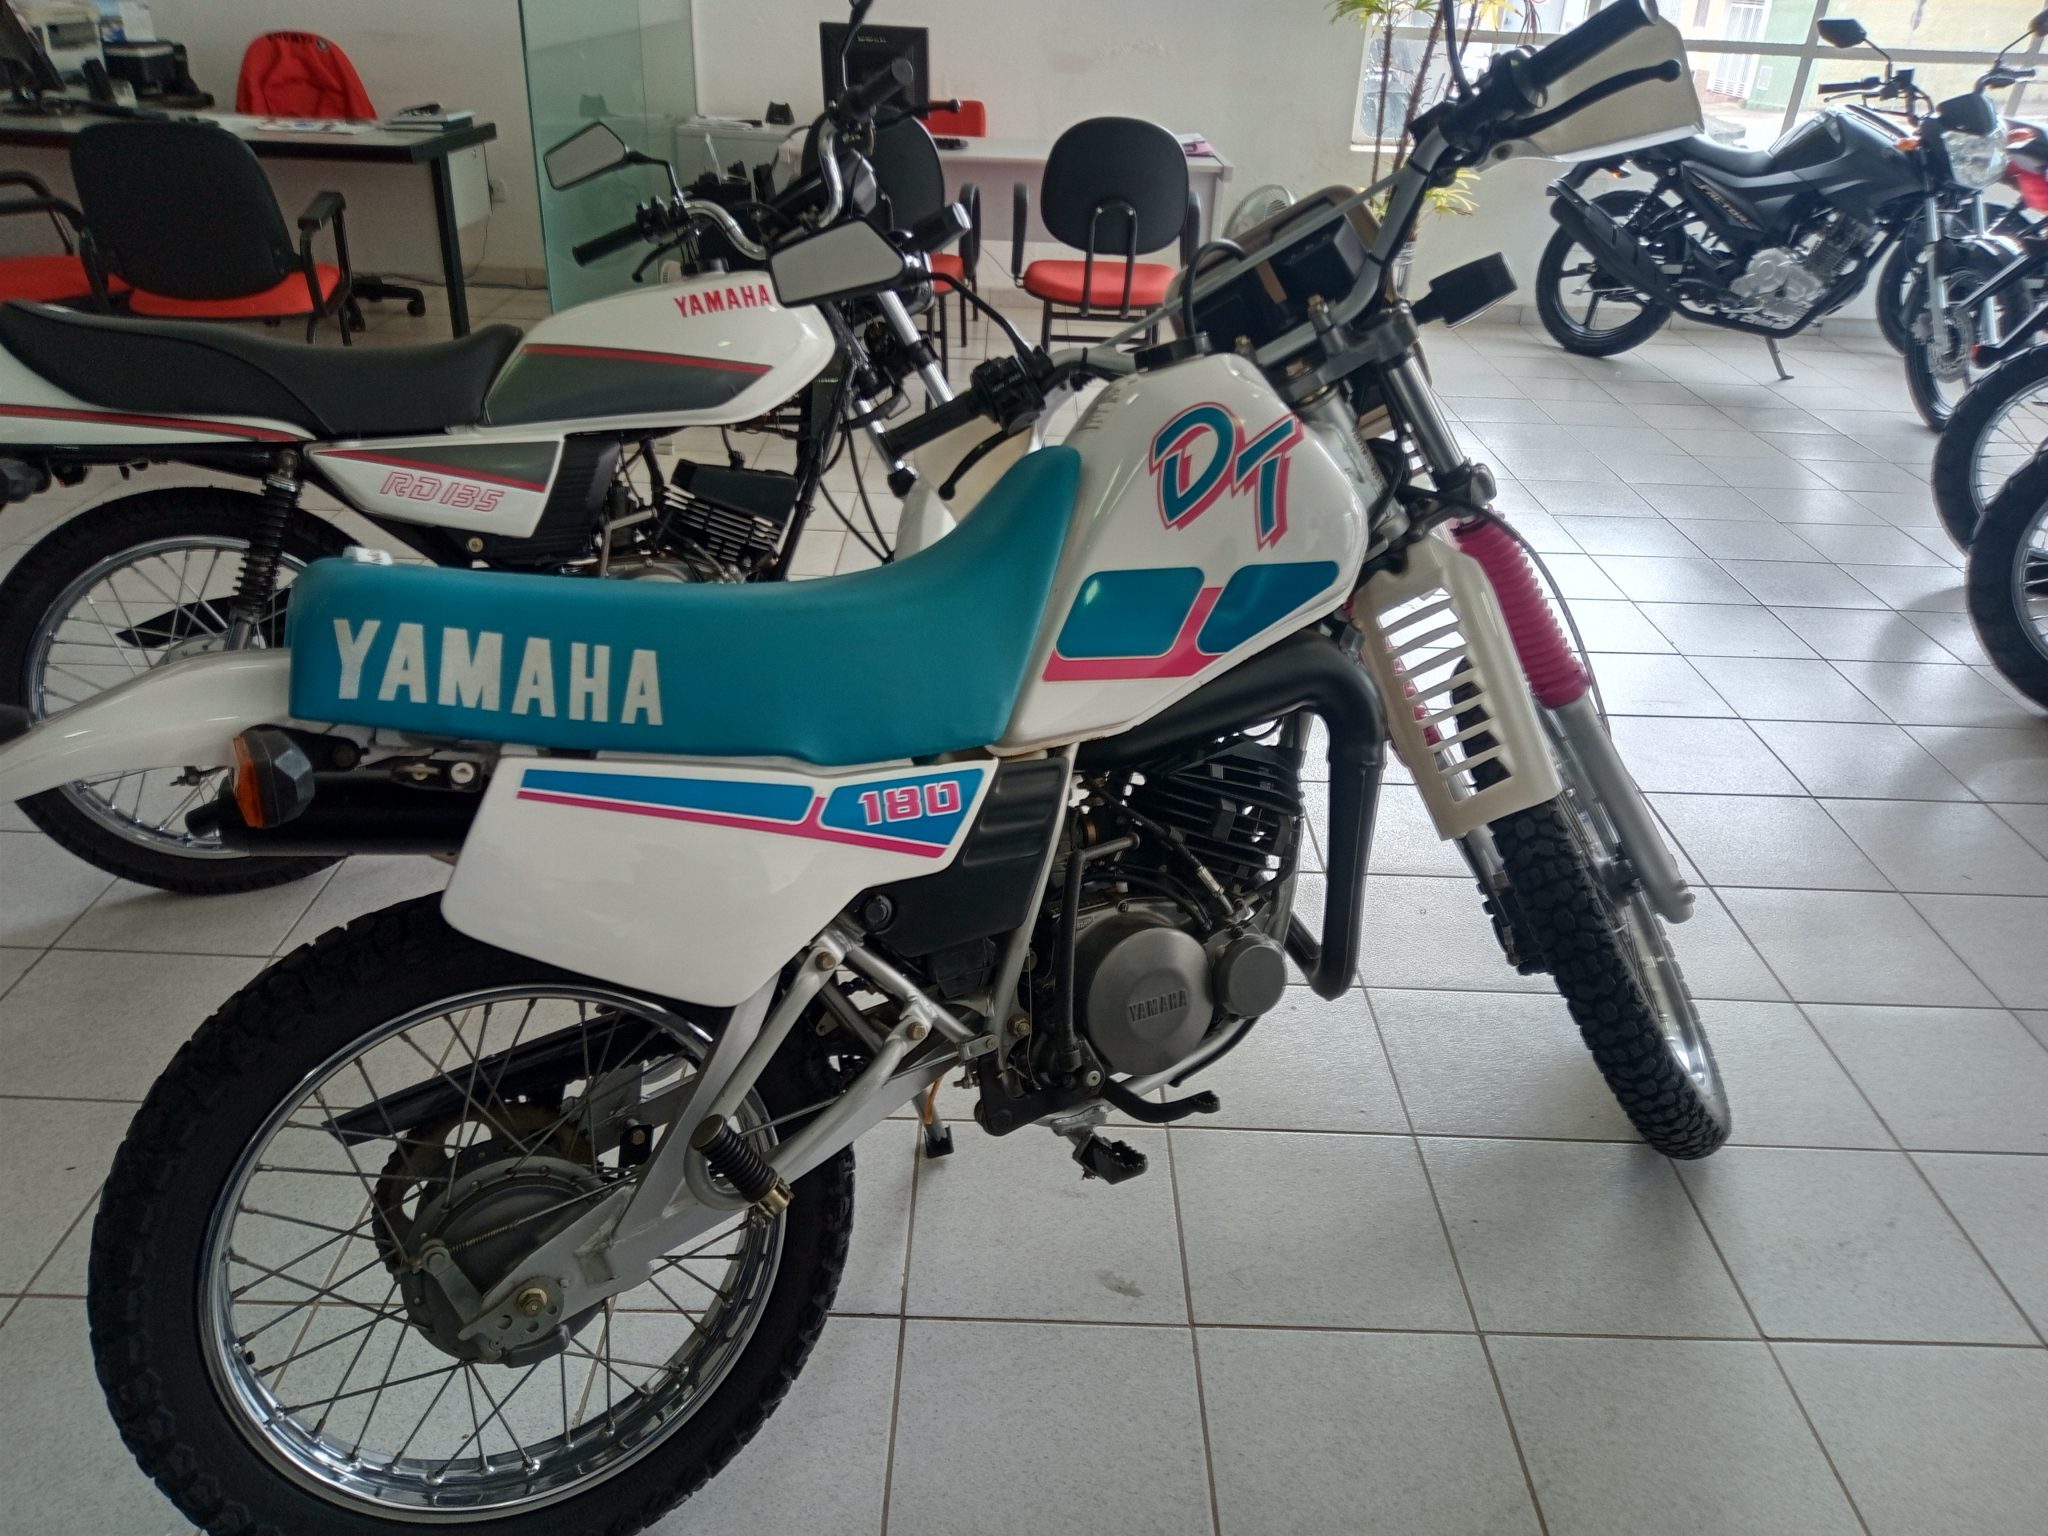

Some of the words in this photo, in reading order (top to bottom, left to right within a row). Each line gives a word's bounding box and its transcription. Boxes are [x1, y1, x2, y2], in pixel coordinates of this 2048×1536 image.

[674, 284, 772, 318] YAMAHA
[379, 471, 505, 512] RD135
[1149, 401, 1305, 552] DT
[333, 618, 663, 726] YAMAHA
[857, 780, 962, 826] 180
[1128, 990, 1188, 1022] YAMAHA
